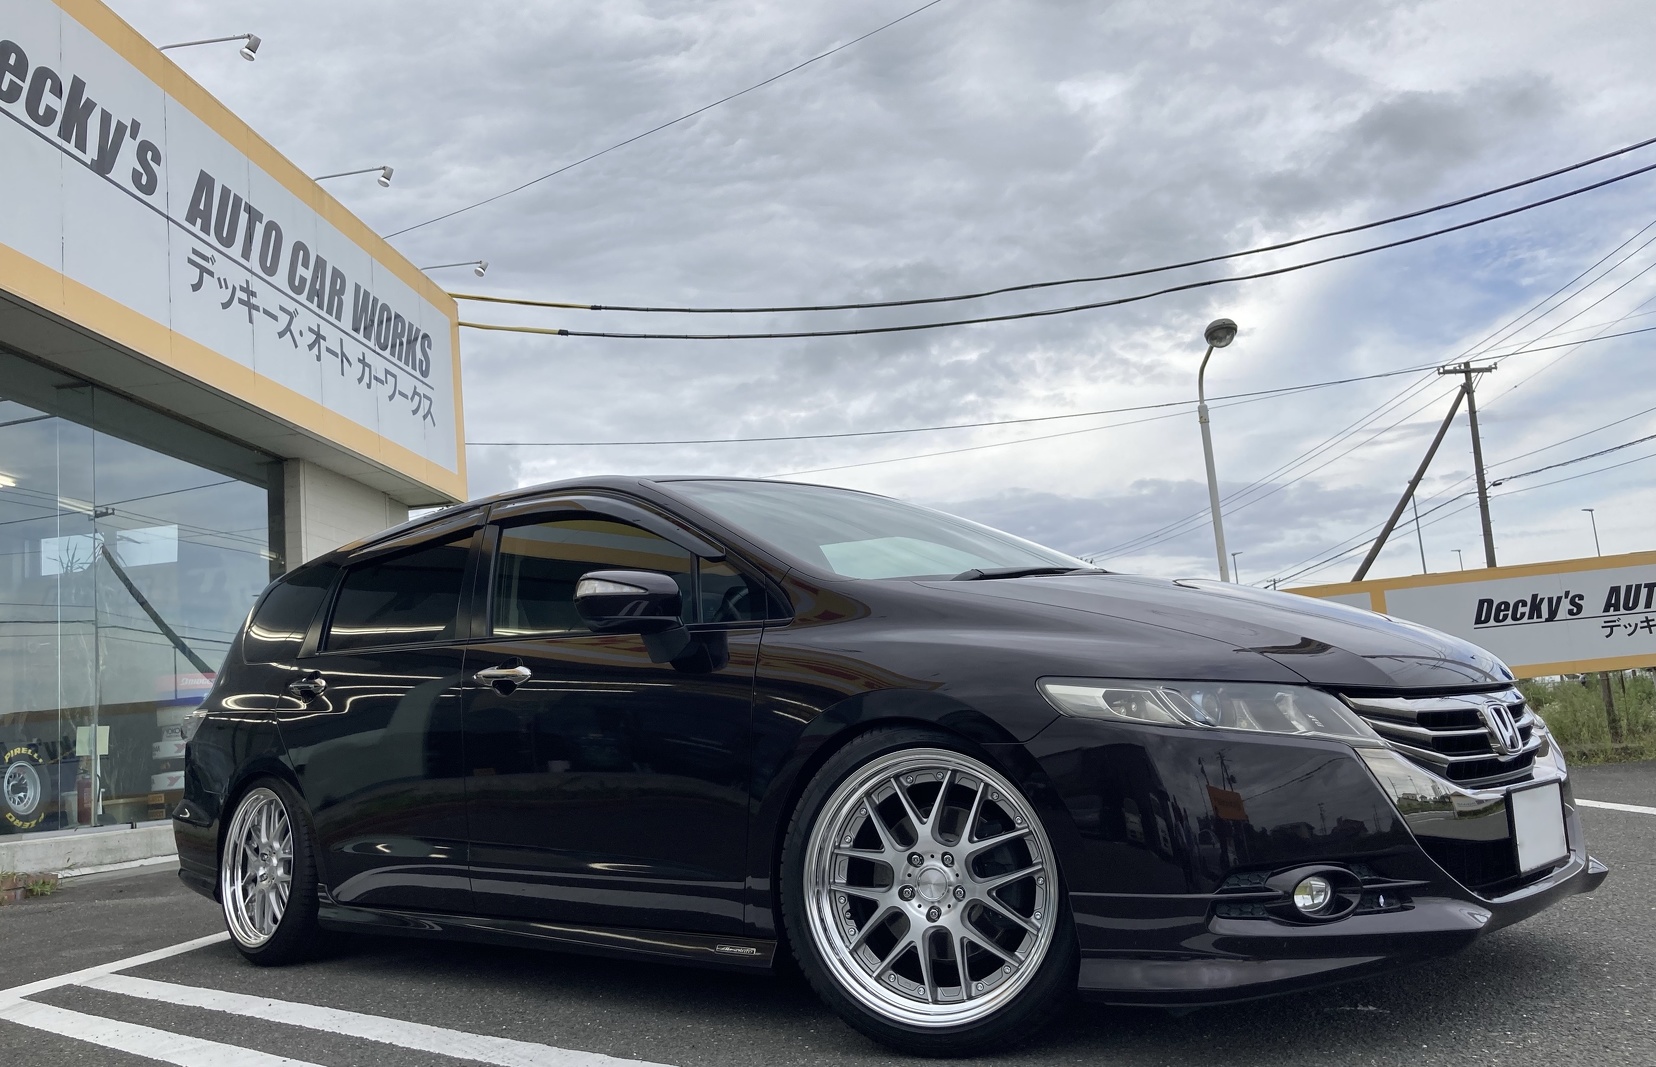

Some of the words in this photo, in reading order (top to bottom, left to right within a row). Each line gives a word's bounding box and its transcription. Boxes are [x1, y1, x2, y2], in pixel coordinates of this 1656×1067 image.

[185, 168, 283, 278] AUTO
[287, 240, 346, 323] CAR
[352, 282, 432, 378] WORKS
[1474, 590, 1584, 625] Decky's
[1602, 582, 1656, 613] AUT
